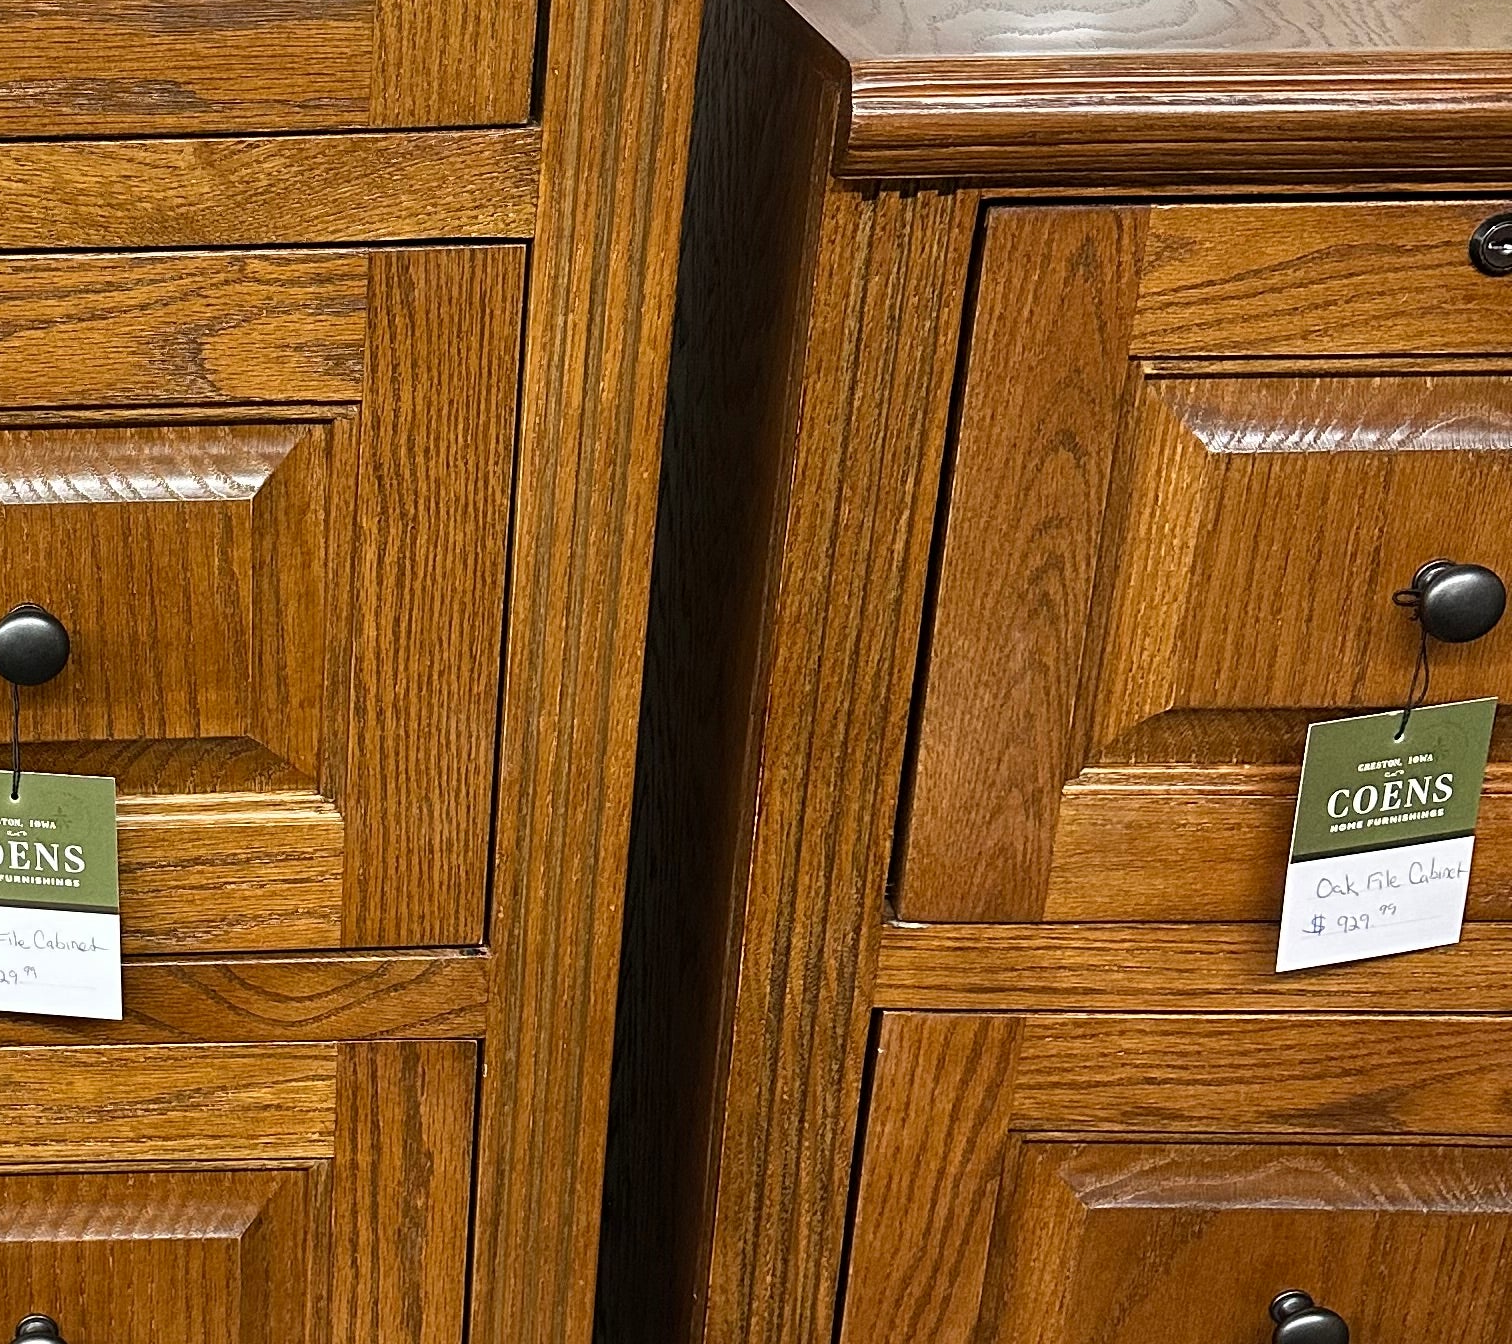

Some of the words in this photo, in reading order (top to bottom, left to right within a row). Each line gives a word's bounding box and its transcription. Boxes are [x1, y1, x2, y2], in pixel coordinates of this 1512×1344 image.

[1408, 753, 1434, 765] IOWA
[1327, 772, 1455, 819] COENS
[29, 819, 57, 830] IOWA
[1330, 820, 1364, 833] HOME
[1367, 807, 1445, 828] FURNISHINGS
[1316, 874, 1359, 899] Oak
[1367, 869, 1401, 890] File
[1408, 858, 1469, 885] Cabinet
